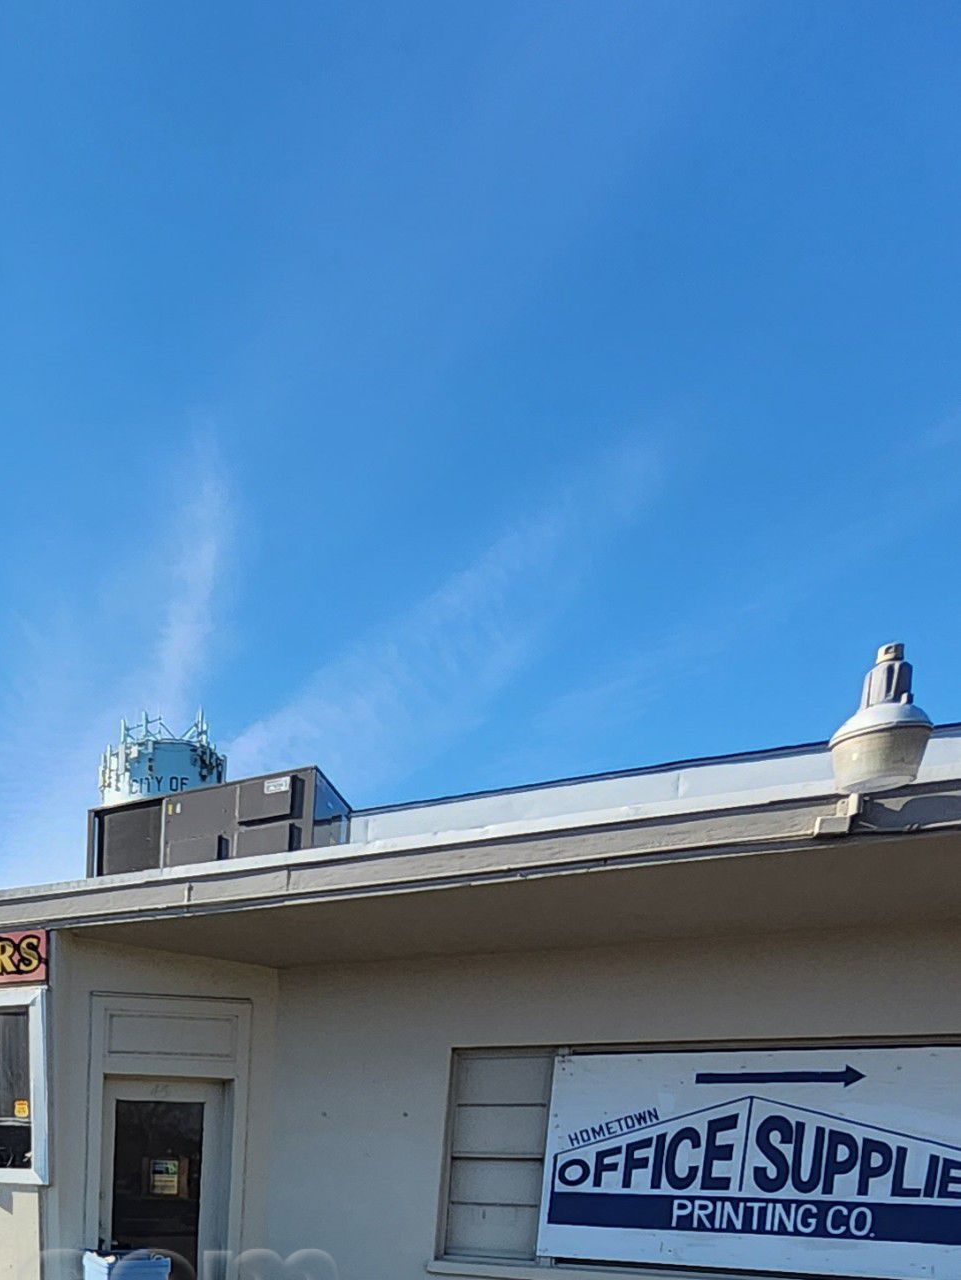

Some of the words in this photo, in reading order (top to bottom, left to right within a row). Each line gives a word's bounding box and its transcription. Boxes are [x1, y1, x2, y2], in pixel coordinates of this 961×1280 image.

[129, 776, 164, 795] CITY
[169, 776, 189, 792] OF
[567, 1107, 661, 1147] HOMETOWN
[558, 1112, 740, 1191] OFFICE
[671, 1199, 818, 1234] PRINTING
[826, 1204, 876, 1238] CO.
